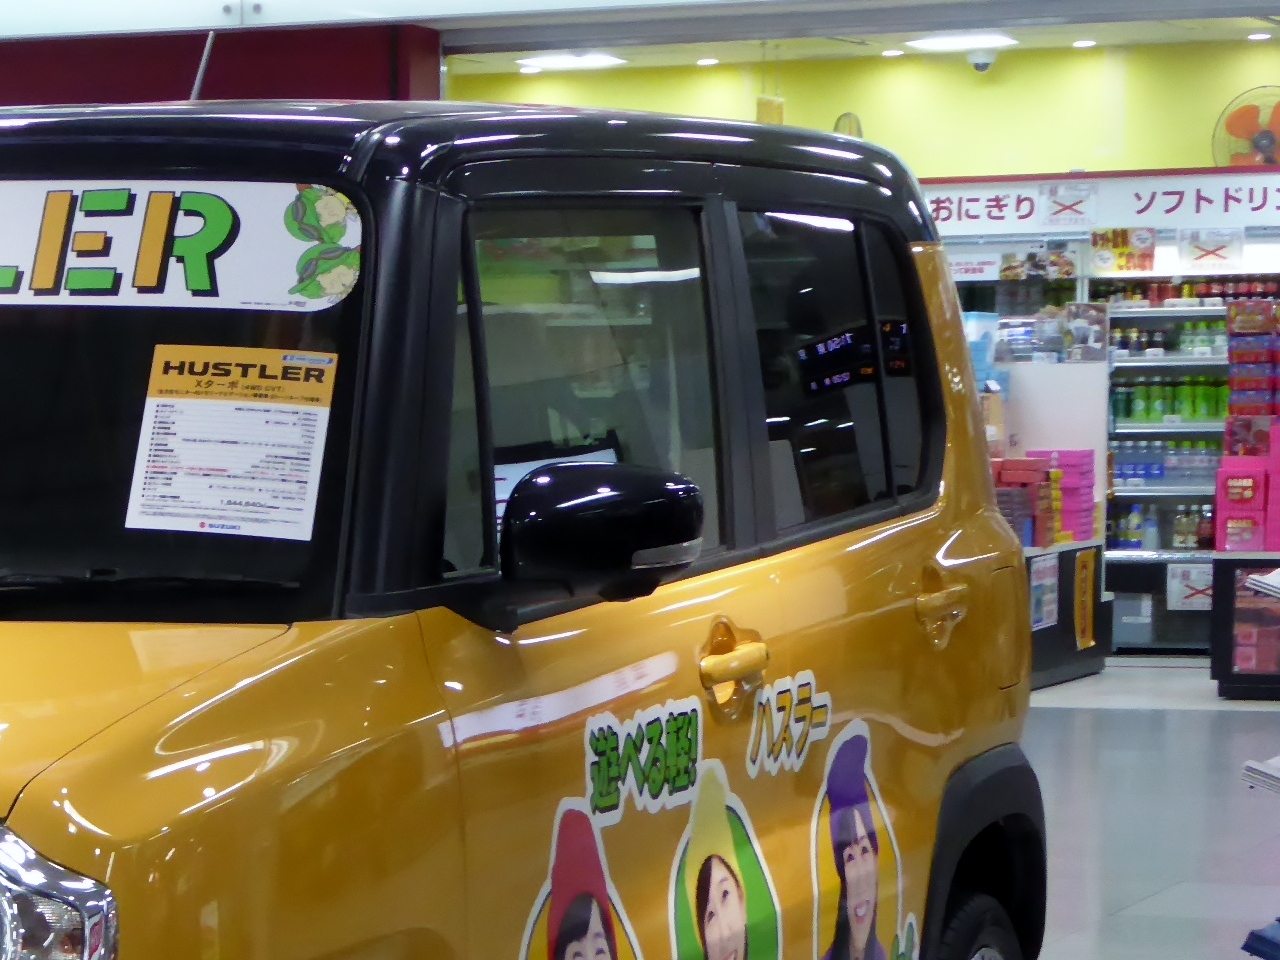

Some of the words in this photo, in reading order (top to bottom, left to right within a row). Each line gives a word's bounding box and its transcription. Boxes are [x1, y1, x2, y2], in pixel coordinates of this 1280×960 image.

[929, 194, 1035, 222] おにぎり
[162, 360, 326, 384] HUSTLER
[750, 682, 827, 765] ハスラー
